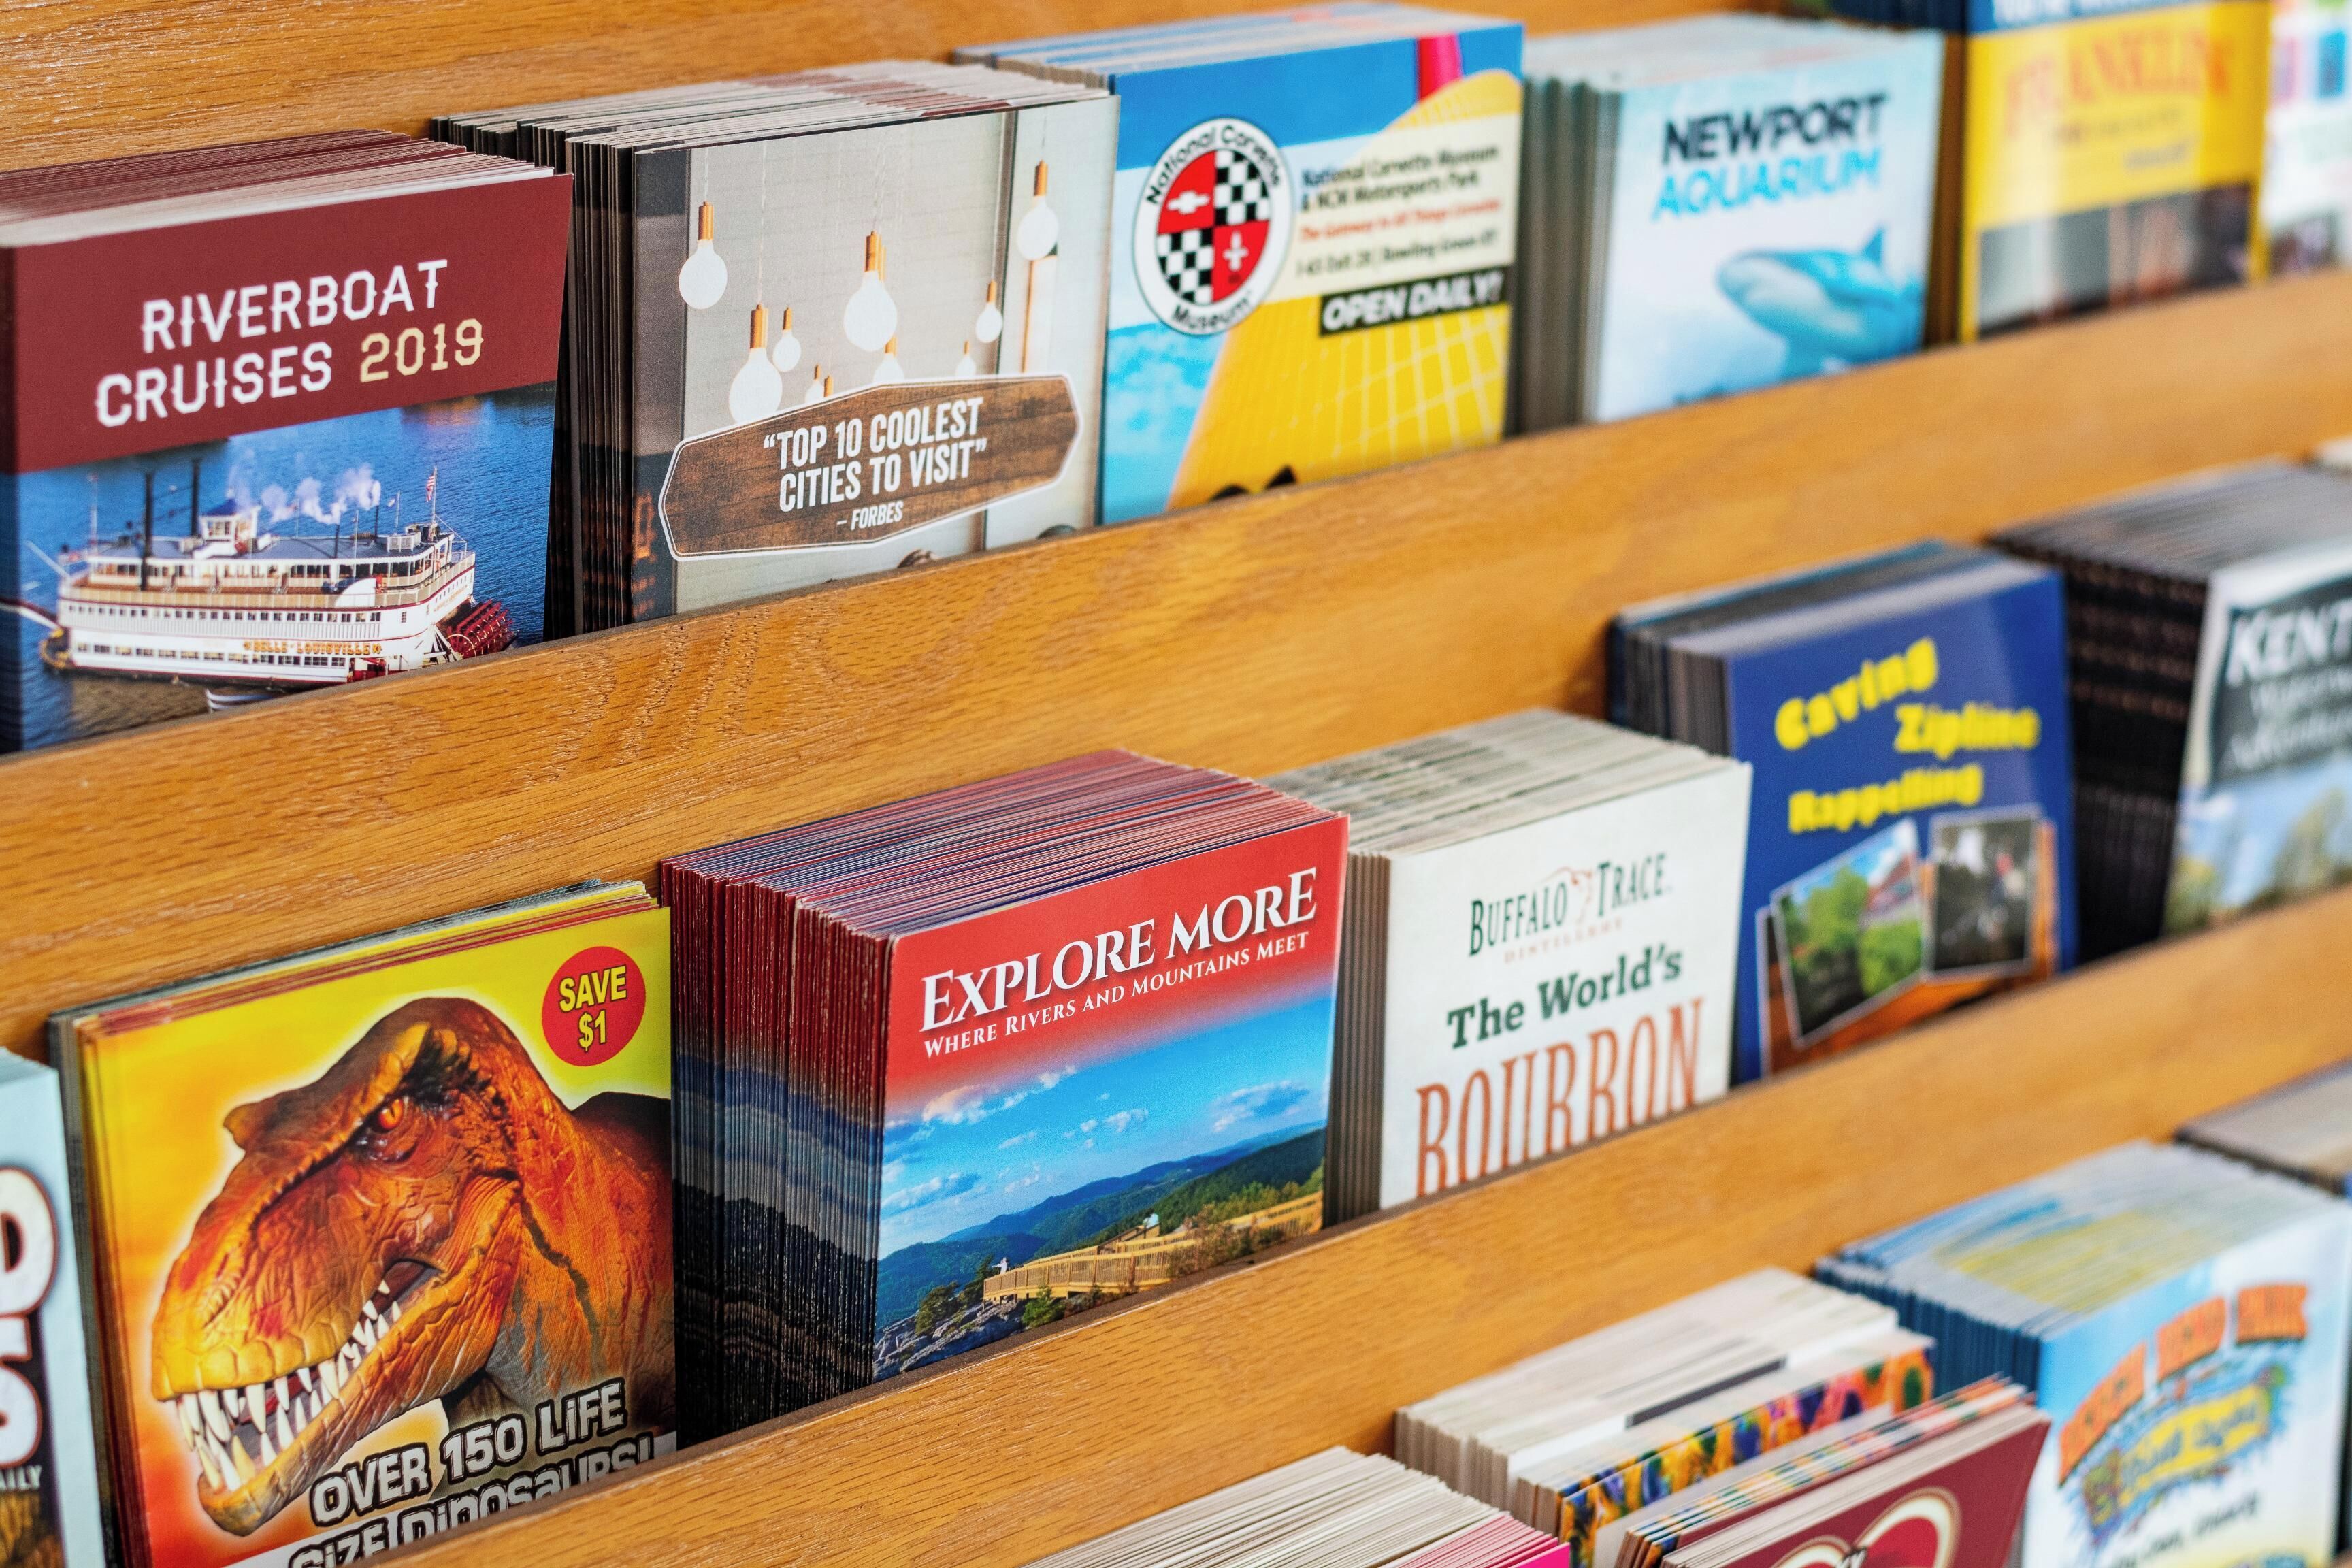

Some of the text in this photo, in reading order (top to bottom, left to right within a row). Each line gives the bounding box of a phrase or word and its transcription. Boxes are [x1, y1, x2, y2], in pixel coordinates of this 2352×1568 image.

[1146, 127, 1217, 204] National
[1663, 92, 1888, 164] NEWPORT
[1652, 146, 1881, 223] AQUARIUM
[141, 259, 448, 353] RIVERBOAT
[1171, 297, 1250, 329] Museum
[1322, 270, 1503, 331] OPEN DAILY!
[95, 318, 484, 427] CRUISES 2019
[834, 417, 862, 461] 10
[869, 397, 984, 452] COOLEST
[779, 461, 862, 513] CITIES
[870, 451, 900, 496] TO
[851, 501, 904, 531] FORBES
[254, 641, 371, 655] BELLE LOUISVILLE
[1775, 636, 1938, 751] Caving
[1894, 702, 2039, 760] Zipline
[1469, 853, 1667, 956] BUFFALO TRACE
[919, 867, 1318, 1032] EXPLORE MORE
[559, 964, 627, 1013] SAVE
[924, 931, 1309, 1059] WHERE RIVERS AND MOUNTAINS MEET
[1447, 943, 1682, 1049] The World's
[578, 1009, 606, 1053] $1
[1416, 998, 1704, 1198] BOURBON
[310, 1377, 627, 1526] OVER 150 LIFE
